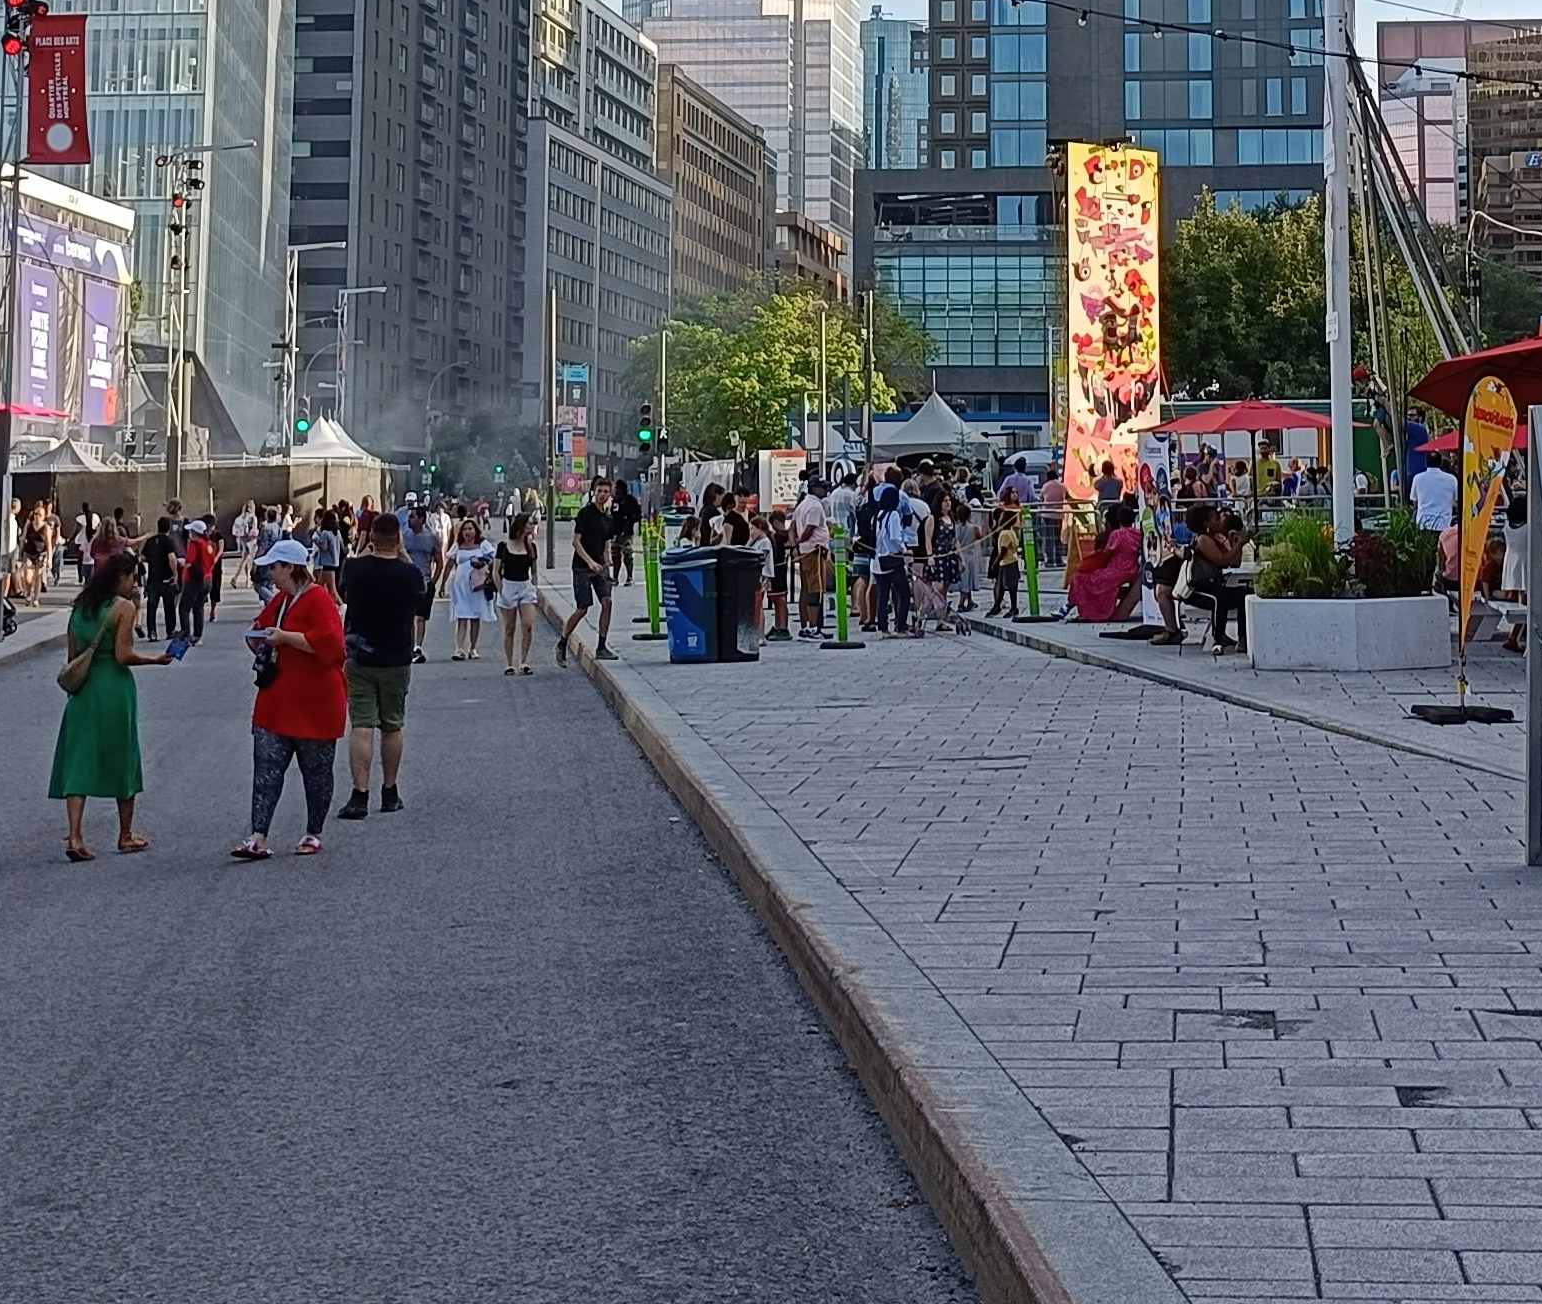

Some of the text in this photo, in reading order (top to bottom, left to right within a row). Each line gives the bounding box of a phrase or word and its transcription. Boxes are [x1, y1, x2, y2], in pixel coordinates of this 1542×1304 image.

[35, 36, 80, 46] PLACE DES ARTS
